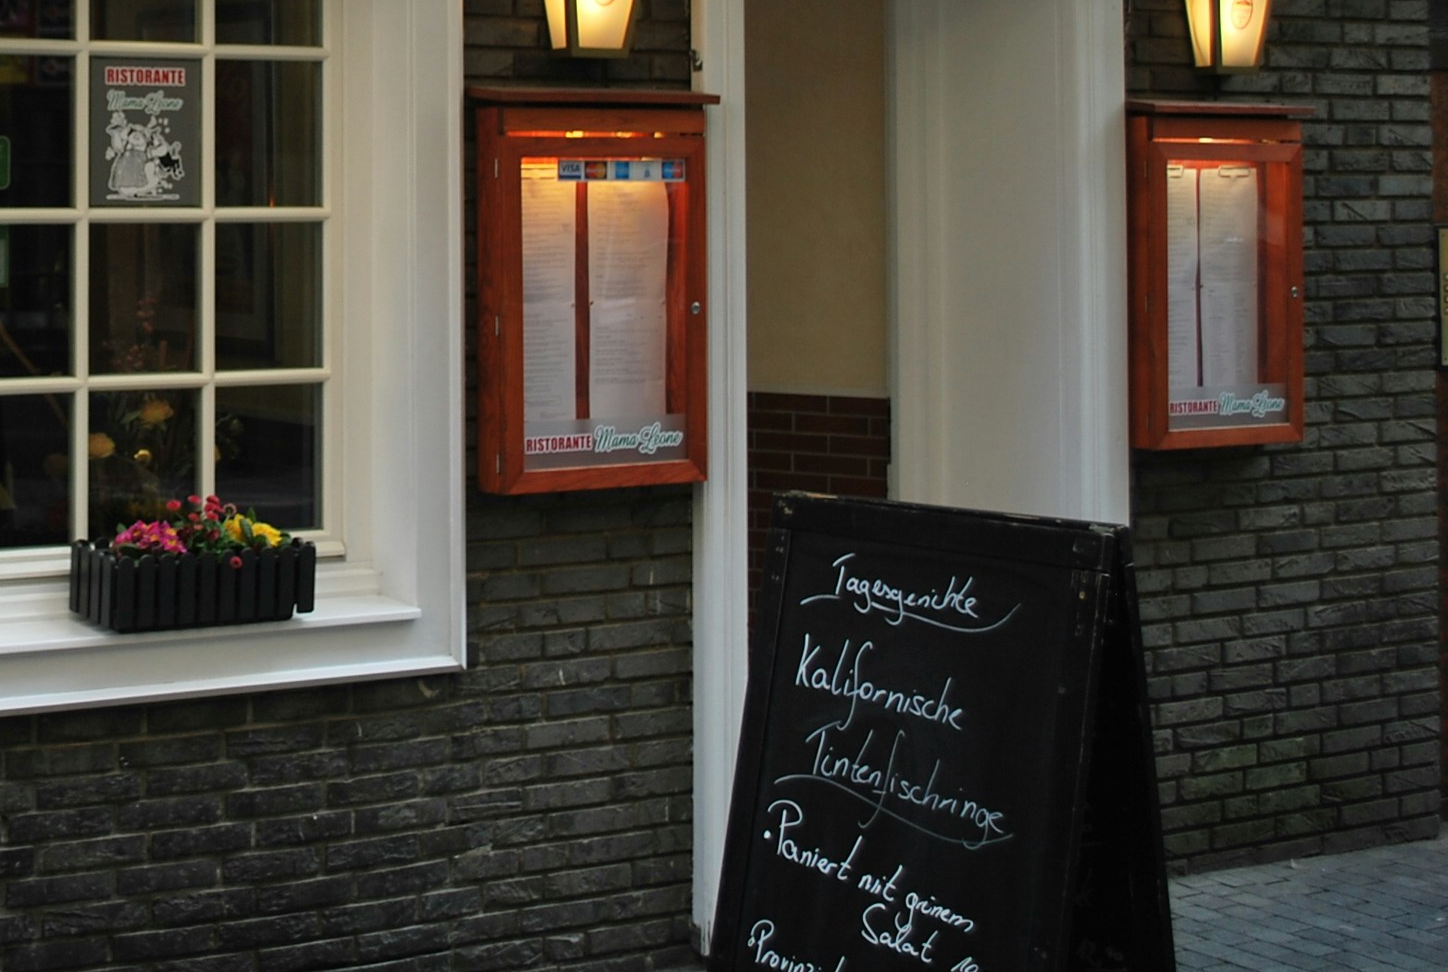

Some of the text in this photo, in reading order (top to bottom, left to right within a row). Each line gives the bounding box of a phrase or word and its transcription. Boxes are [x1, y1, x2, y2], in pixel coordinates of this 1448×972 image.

[106, 68, 184, 84] RISTORANTE
[561, 163, 580, 173] VISA
[1170, 400, 1217, 414] RISTORANTE
[526, 422, 683, 454] RISTORANTE Mama Leone
[794, 633, 963, 730] Kalifornische
[806, 720, 1006, 850] Tintenfischringe
[767, 799, 863, 881] Paniert
[857, 864, 904, 902] mit
[861, 903, 939, 963] Salat
